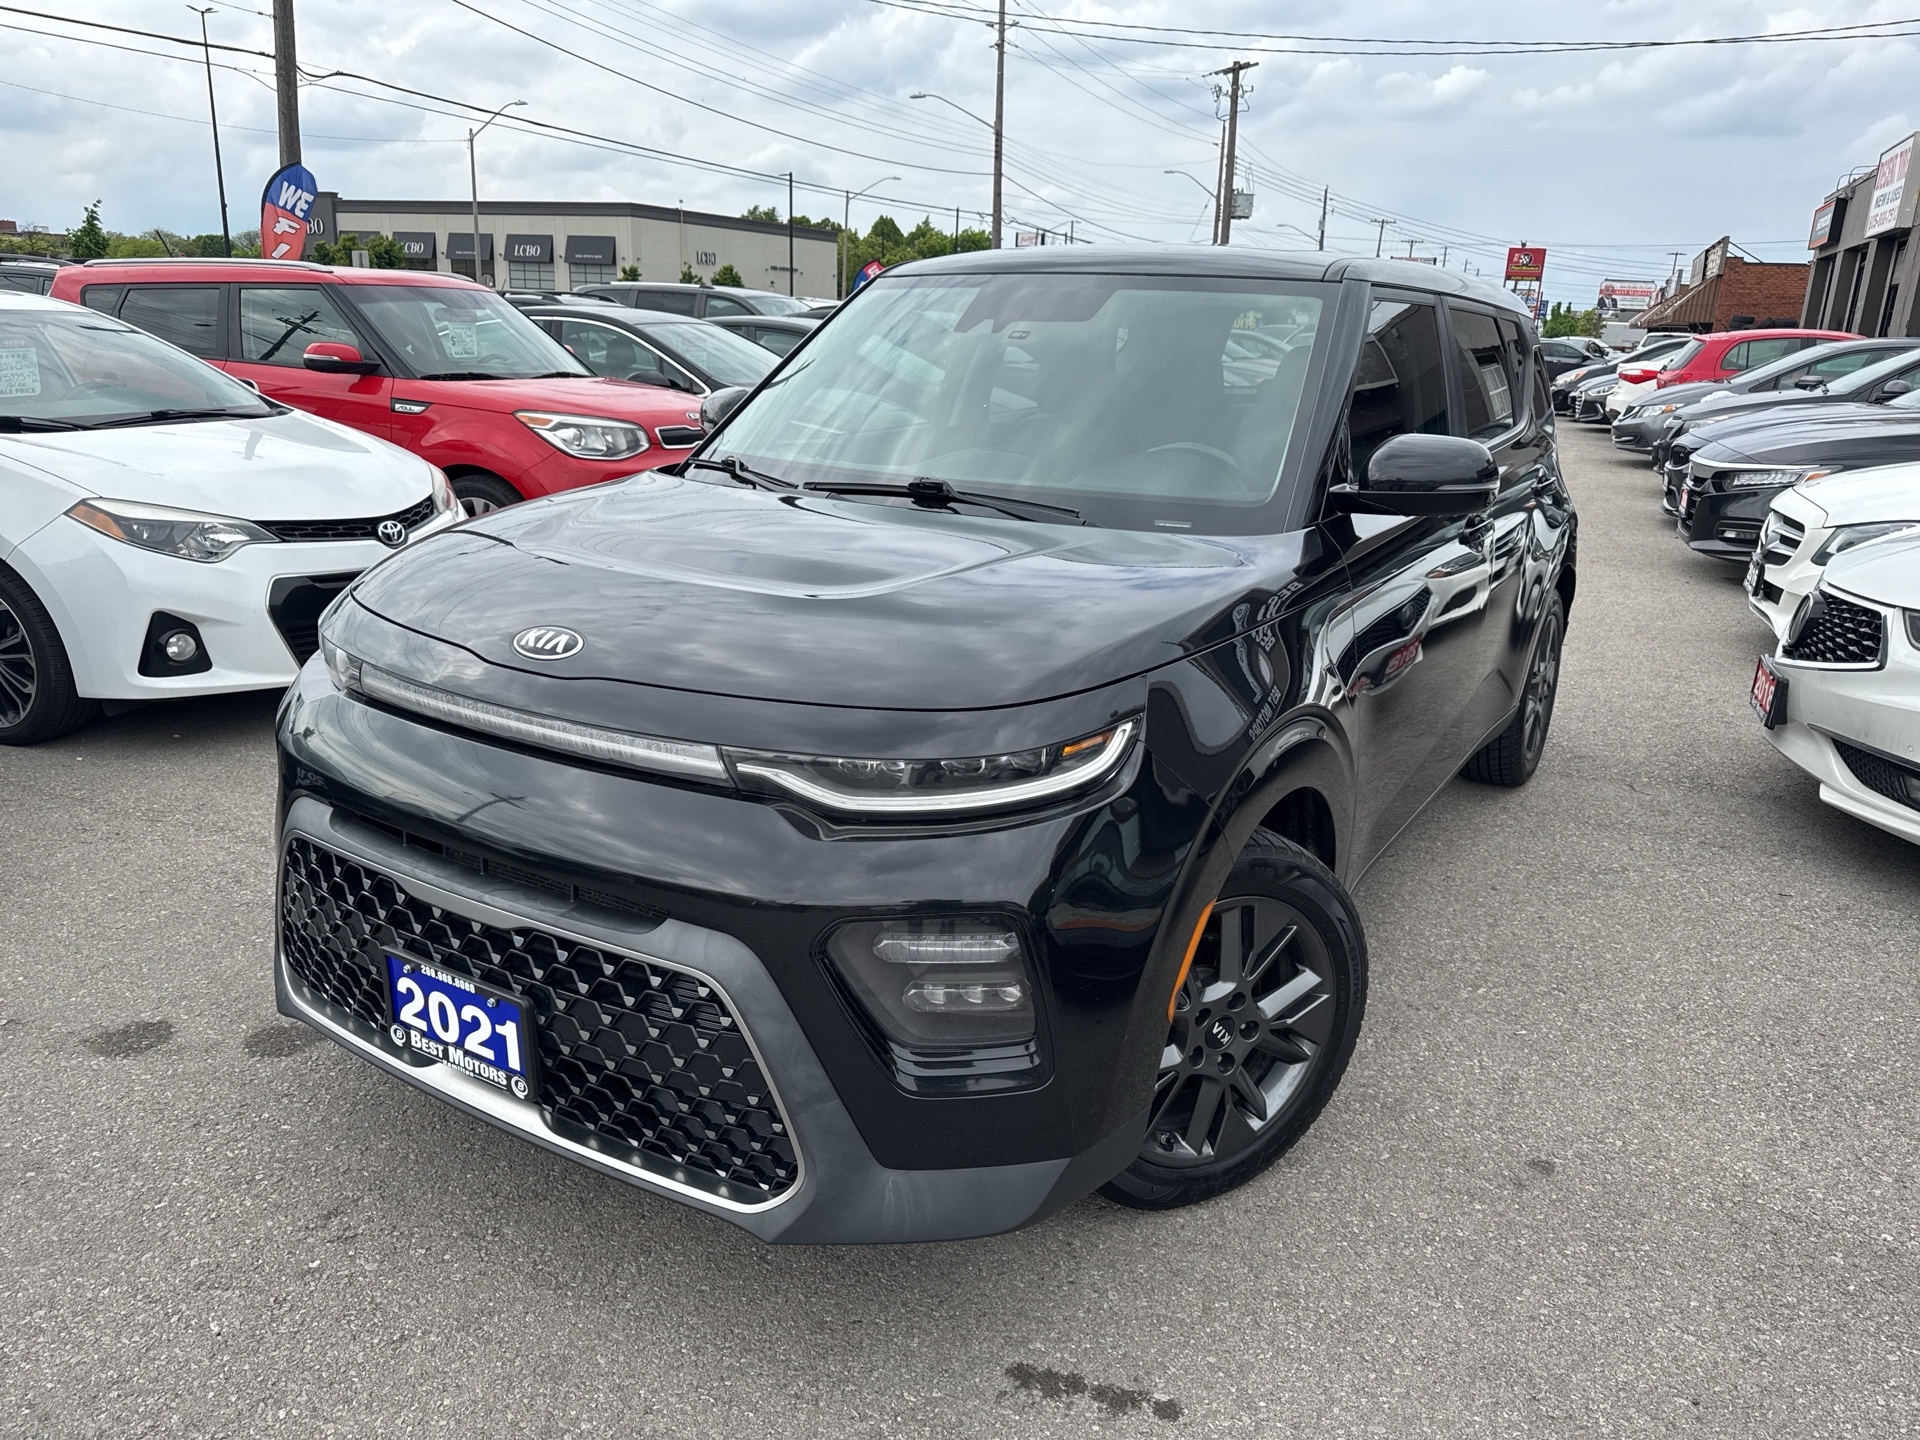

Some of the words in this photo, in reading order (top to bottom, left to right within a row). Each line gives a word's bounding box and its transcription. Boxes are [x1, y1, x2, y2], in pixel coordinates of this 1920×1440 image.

[278, 181, 315, 218] WE
[307, 217, 324, 235] BO
[402, 241, 425, 254] CBO
[514, 244, 541, 257] LCBO
[520, 629, 570, 654] KIA
[1754, 669, 1775, 713] 2018
[396, 976, 521, 1072] 2021
[1212, 1021, 1231, 1045] KIA
[410, 1029, 445, 1059] BEST
[448, 1045, 507, 1086] MOTORS
[442, 1059, 474, 1078] Hamilton
